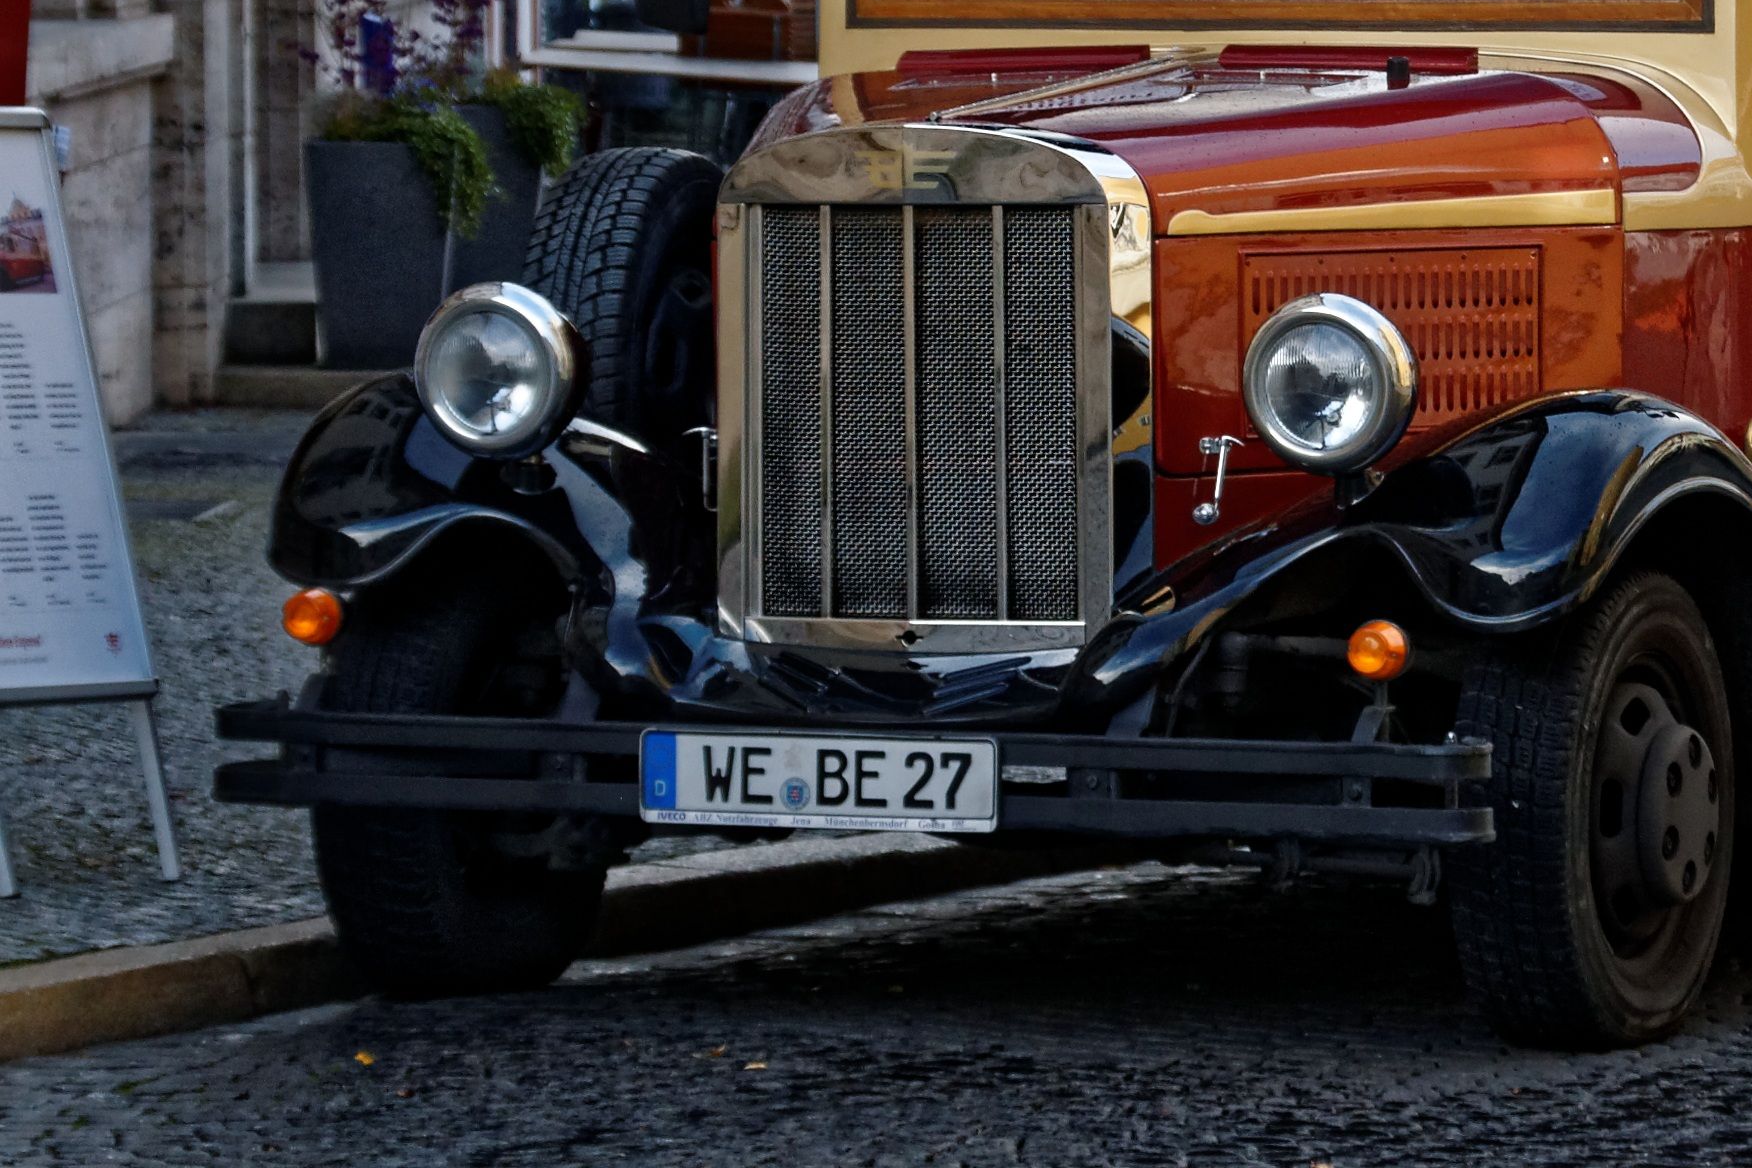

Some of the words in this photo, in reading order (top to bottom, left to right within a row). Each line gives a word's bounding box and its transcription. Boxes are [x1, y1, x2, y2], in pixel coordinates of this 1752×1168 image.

[654, 780, 667, 797] D
[702, 744, 774, 805] WE
[815, 748, 889, 808] BE
[903, 751, 973, 810] 27
[656, 810, 687, 822] IVECO
